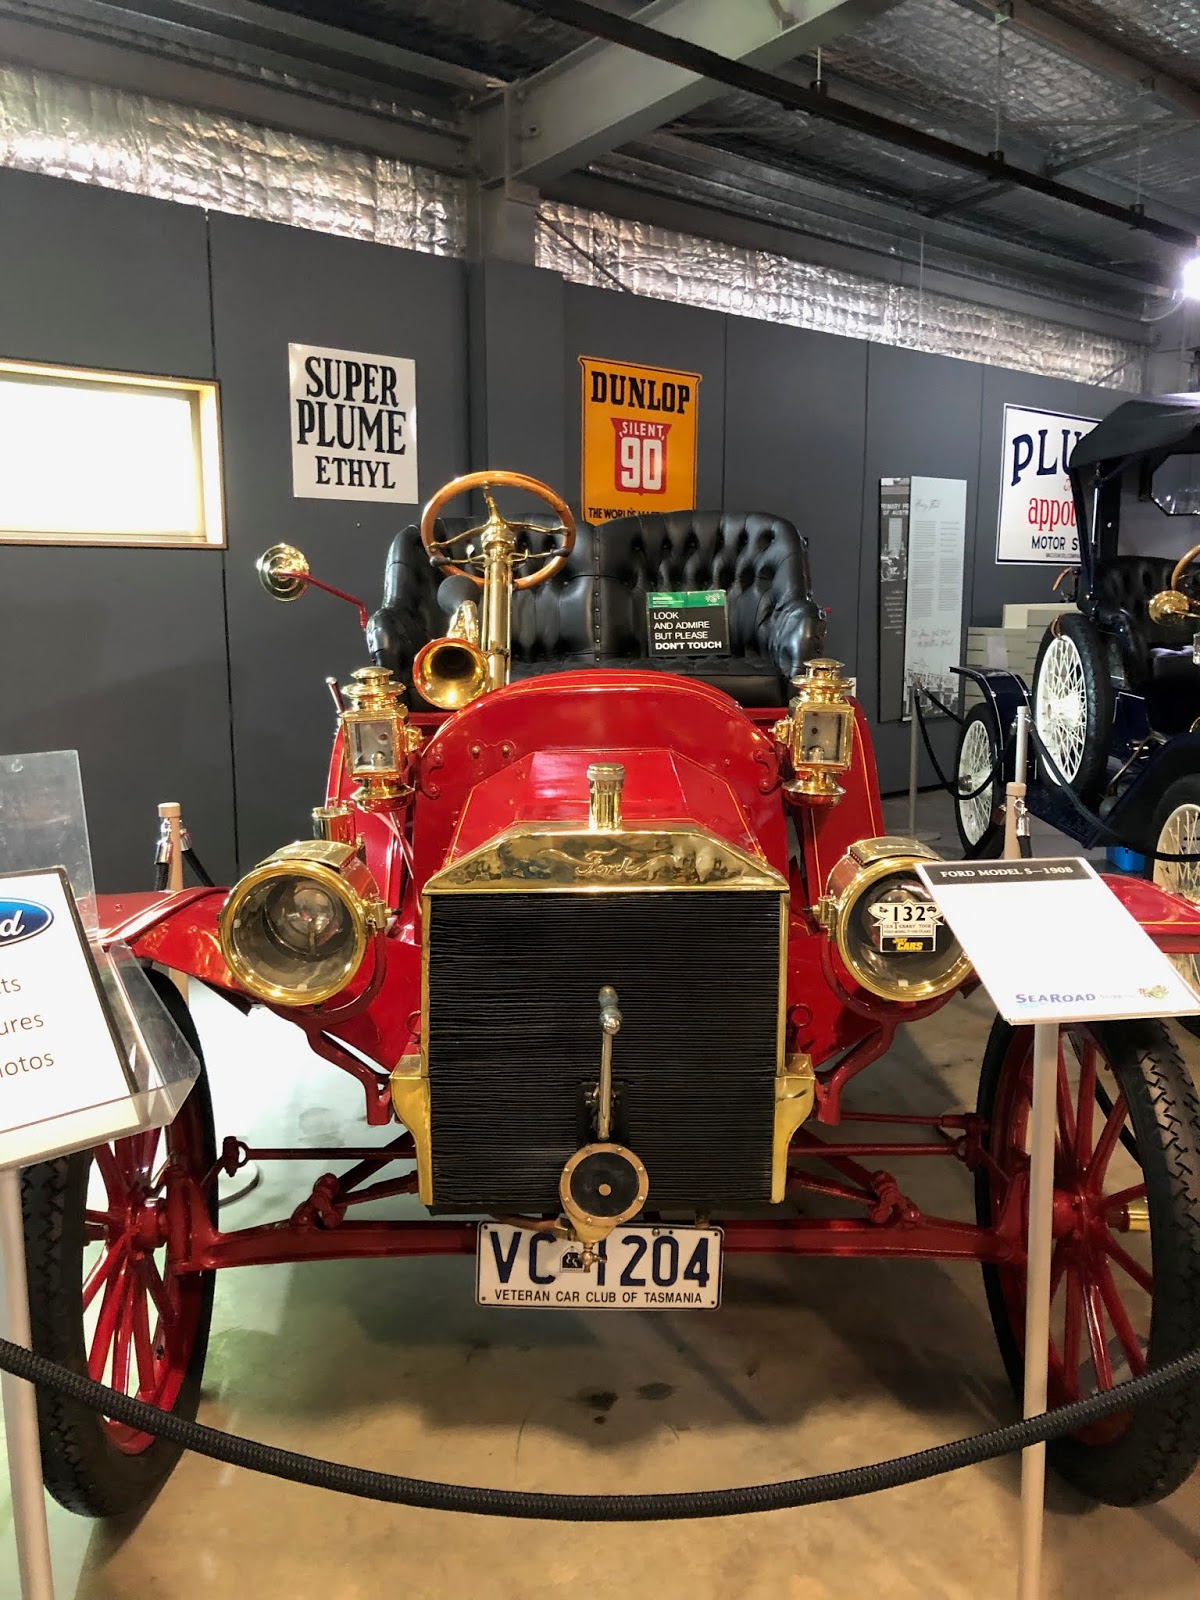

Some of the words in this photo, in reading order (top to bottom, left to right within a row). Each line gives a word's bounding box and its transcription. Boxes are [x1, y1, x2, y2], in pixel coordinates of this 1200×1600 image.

[304, 356, 399, 407] SUPER
[591, 371, 690, 414] DUNLOP
[296, 399, 406, 455] PLUME
[621, 421, 665, 438] SILENT
[621, 437, 663, 490] 90
[1011, 429, 1083, 487] PLU
[315, 455, 396, 489] ETHYL
[588, 507, 602, 519] THE
[1031, 535, 1066, 550] MOTOR
[653, 611, 680, 620] LOOK
[654, 622, 674, 630] AND
[675, 620, 711, 630] ADMIRE
[654, 632, 673, 640] BUT
[674, 630, 709, 640] PLEASE
[655, 642, 686, 650] DON'T
[687, 640, 723, 650] TOUCH
[575, 848, 634, 877] Ford
[940, 870, 976, 879] FORD
[977, 867, 1024, 878] MODEL
[894, 906, 926, 922] 132
[896, 942, 924, 951] CARS
[0, 1013, 45, 1036] ures
[0, 1052, 55, 1079] otos
[490, 1231, 558, 1285] VC
[596, 1235, 710, 1288] 1204
[495, 1289, 550, 1302] VETERAN
[556, 1290, 580, 1302] CAR
[586, 1291, 616, 1303] CLUB
[622, 1292, 638, 1303] OF
[645, 1292, 702, 1303] TASMANIA
